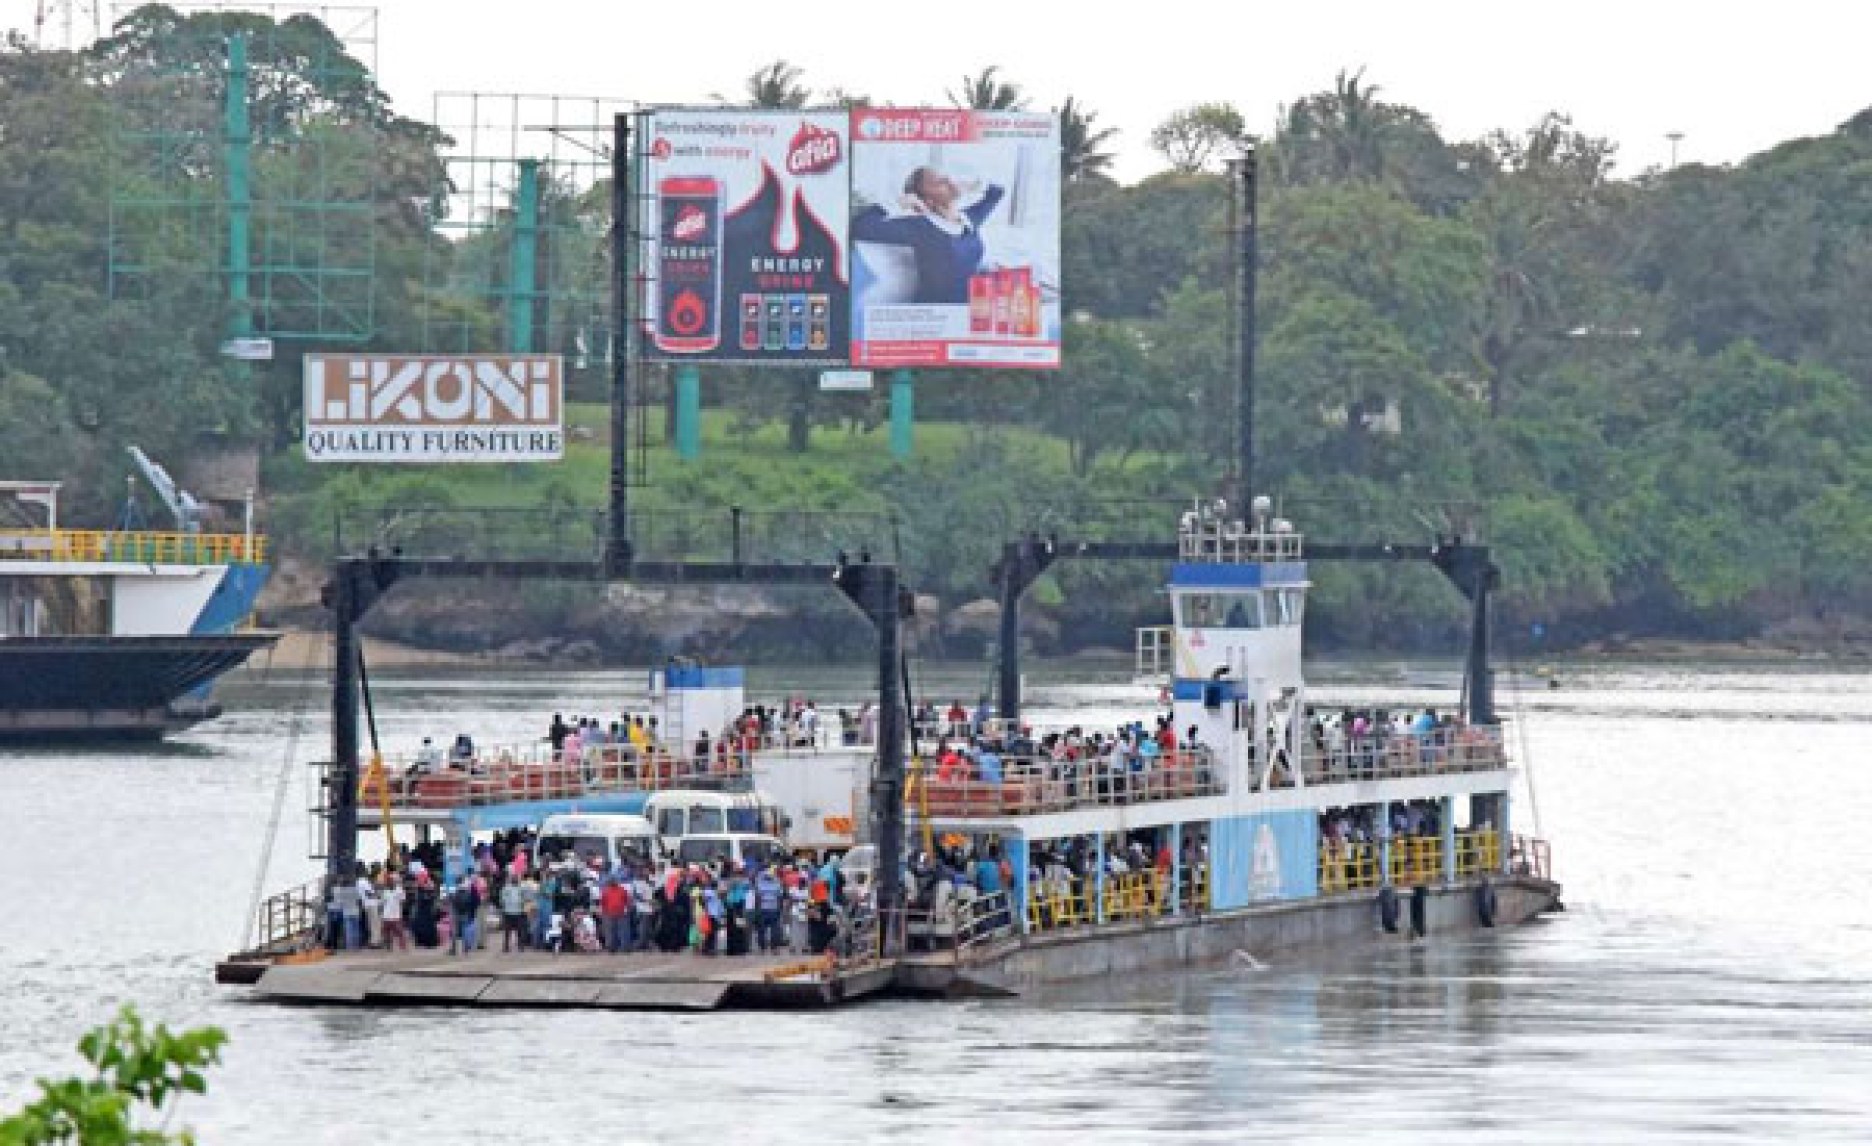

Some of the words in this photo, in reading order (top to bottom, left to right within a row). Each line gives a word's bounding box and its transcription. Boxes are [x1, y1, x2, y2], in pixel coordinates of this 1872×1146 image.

[882, 118, 921, 138] DEEP
[673, 146, 703, 156] with
[705, 148, 752, 159] energy
[751, 258, 824, 272] ENERGY
[308, 430, 413, 455] QUALITY
[423, 429, 560, 452] FURNITURE
